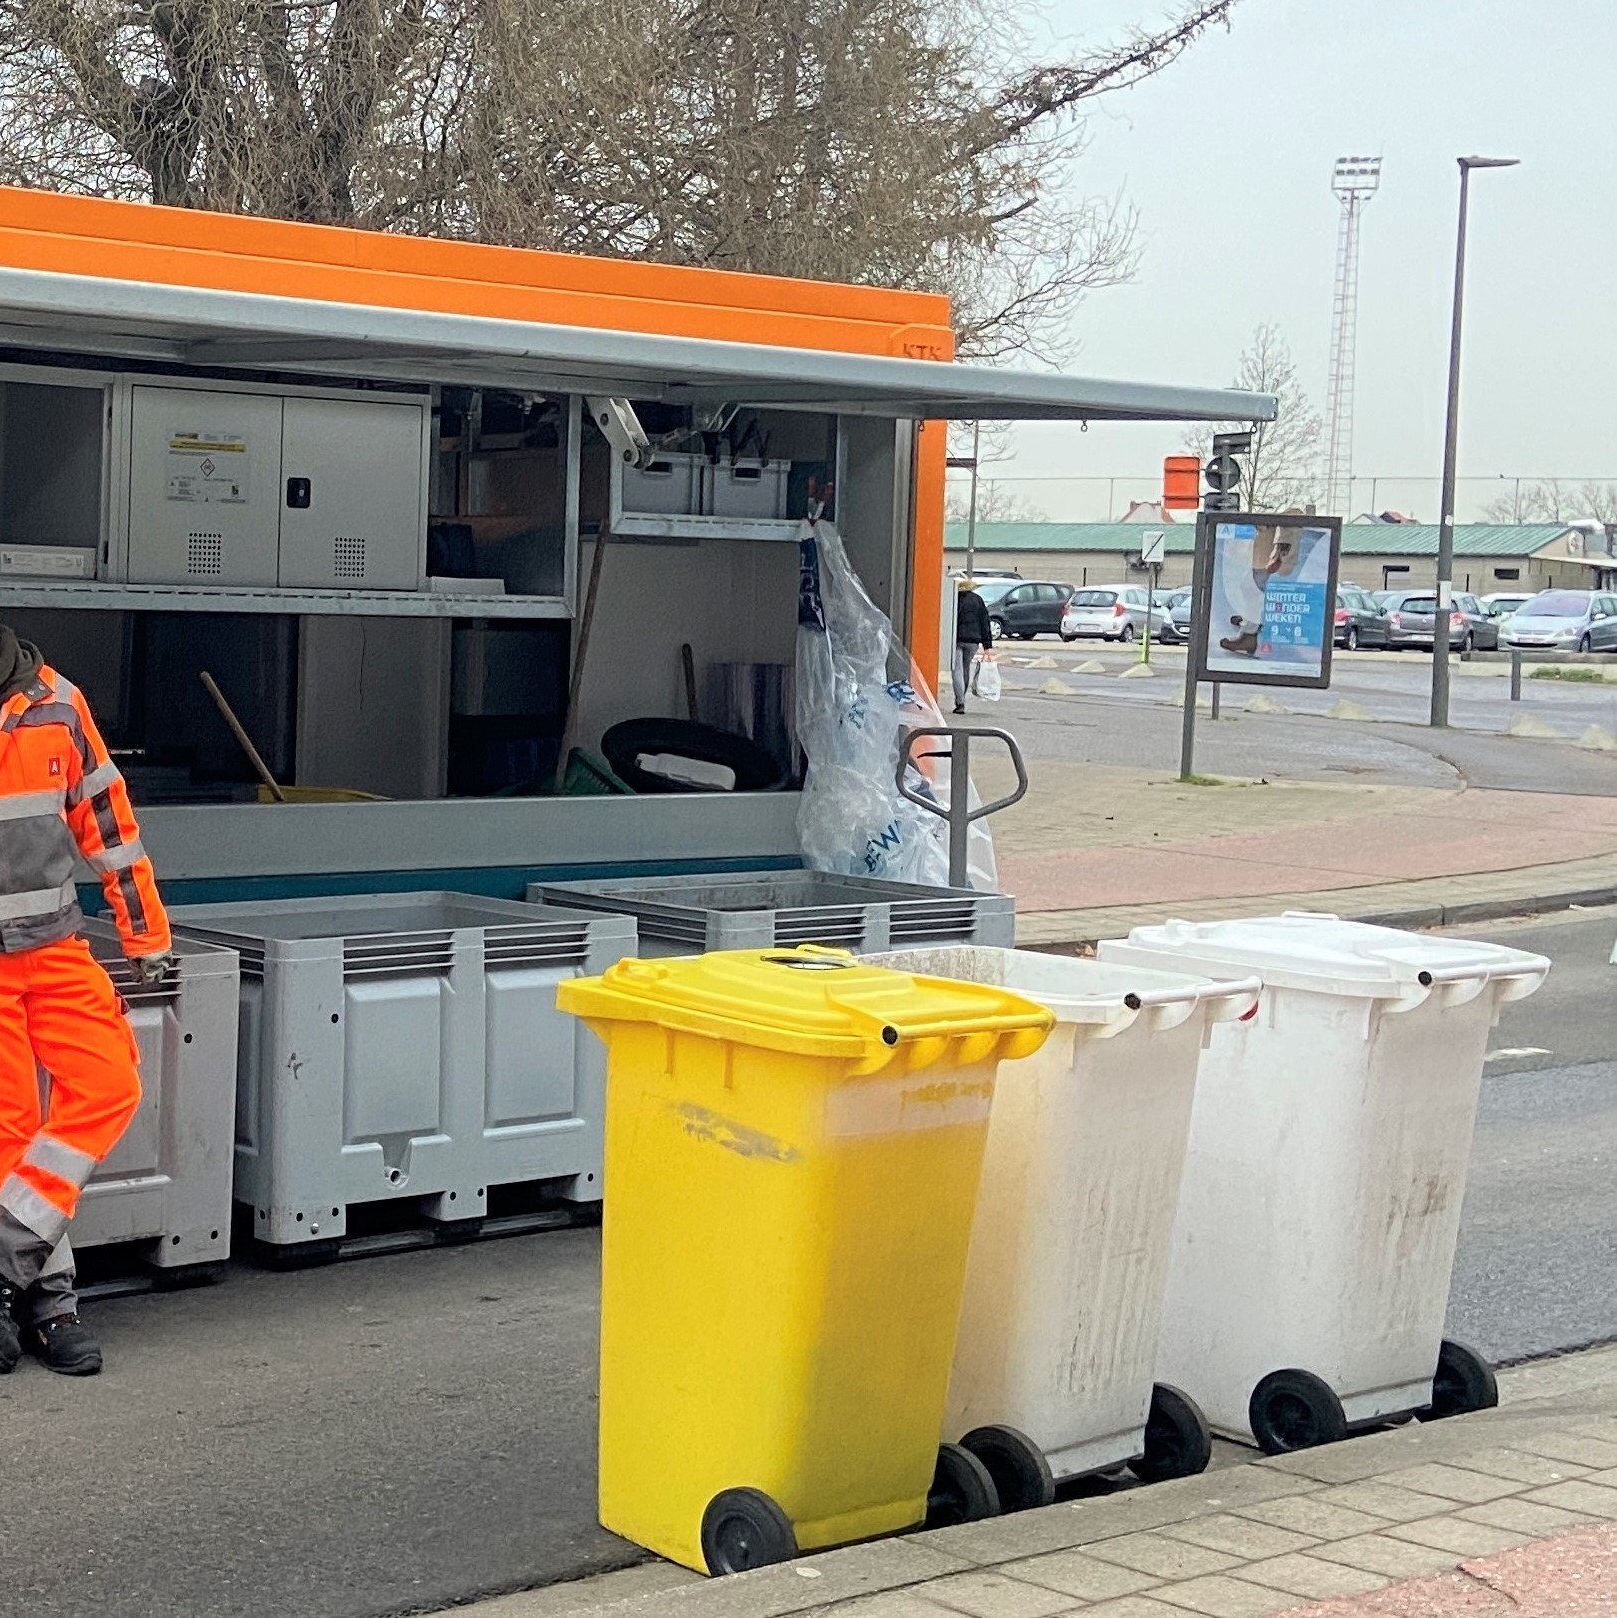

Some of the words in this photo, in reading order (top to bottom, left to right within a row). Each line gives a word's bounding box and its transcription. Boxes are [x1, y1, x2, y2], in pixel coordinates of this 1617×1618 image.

[903, 343, 942, 361] KTK
[1266, 591, 1307, 603] WINTER
[1265, 613, 1302, 624] WEKEN
[1271, 625, 1279, 636] 9
